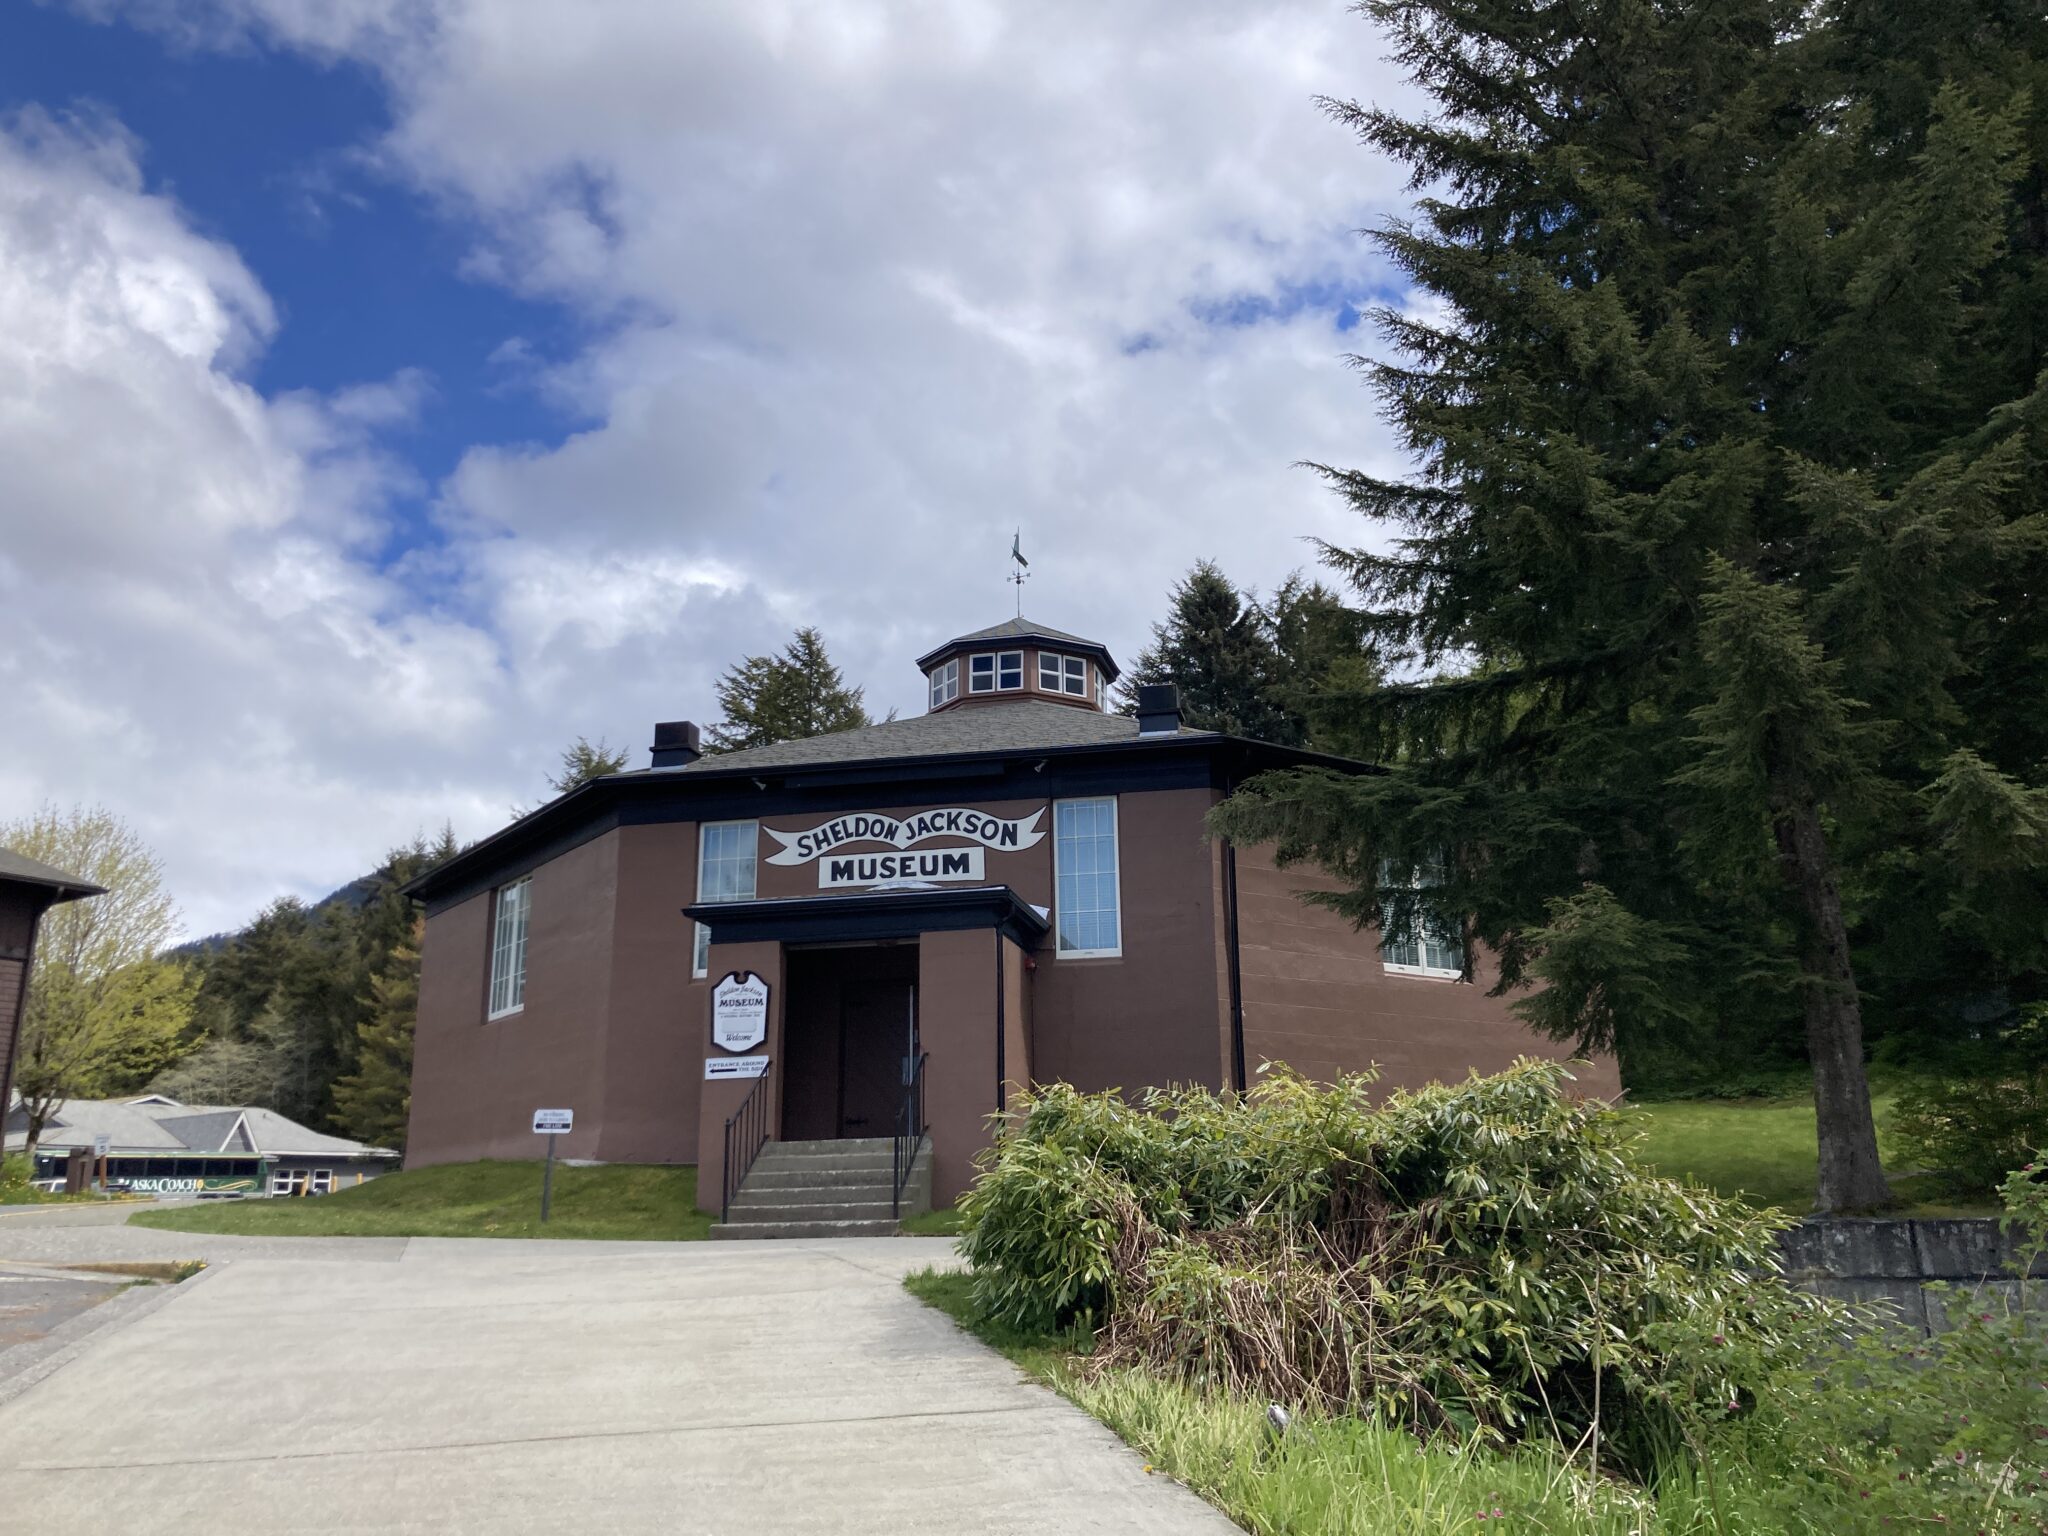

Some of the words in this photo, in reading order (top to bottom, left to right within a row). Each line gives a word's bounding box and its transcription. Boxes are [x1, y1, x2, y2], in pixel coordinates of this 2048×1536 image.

[797, 817, 899, 858] SHELDON
[905, 811, 1018, 846] JACKSON
[830, 853, 970, 882] MUSEUM
[719, 998, 764, 1008] MUSEUM
[726, 1033, 752, 1041] Welcome
[158, 1178, 197, 1193] COACH
